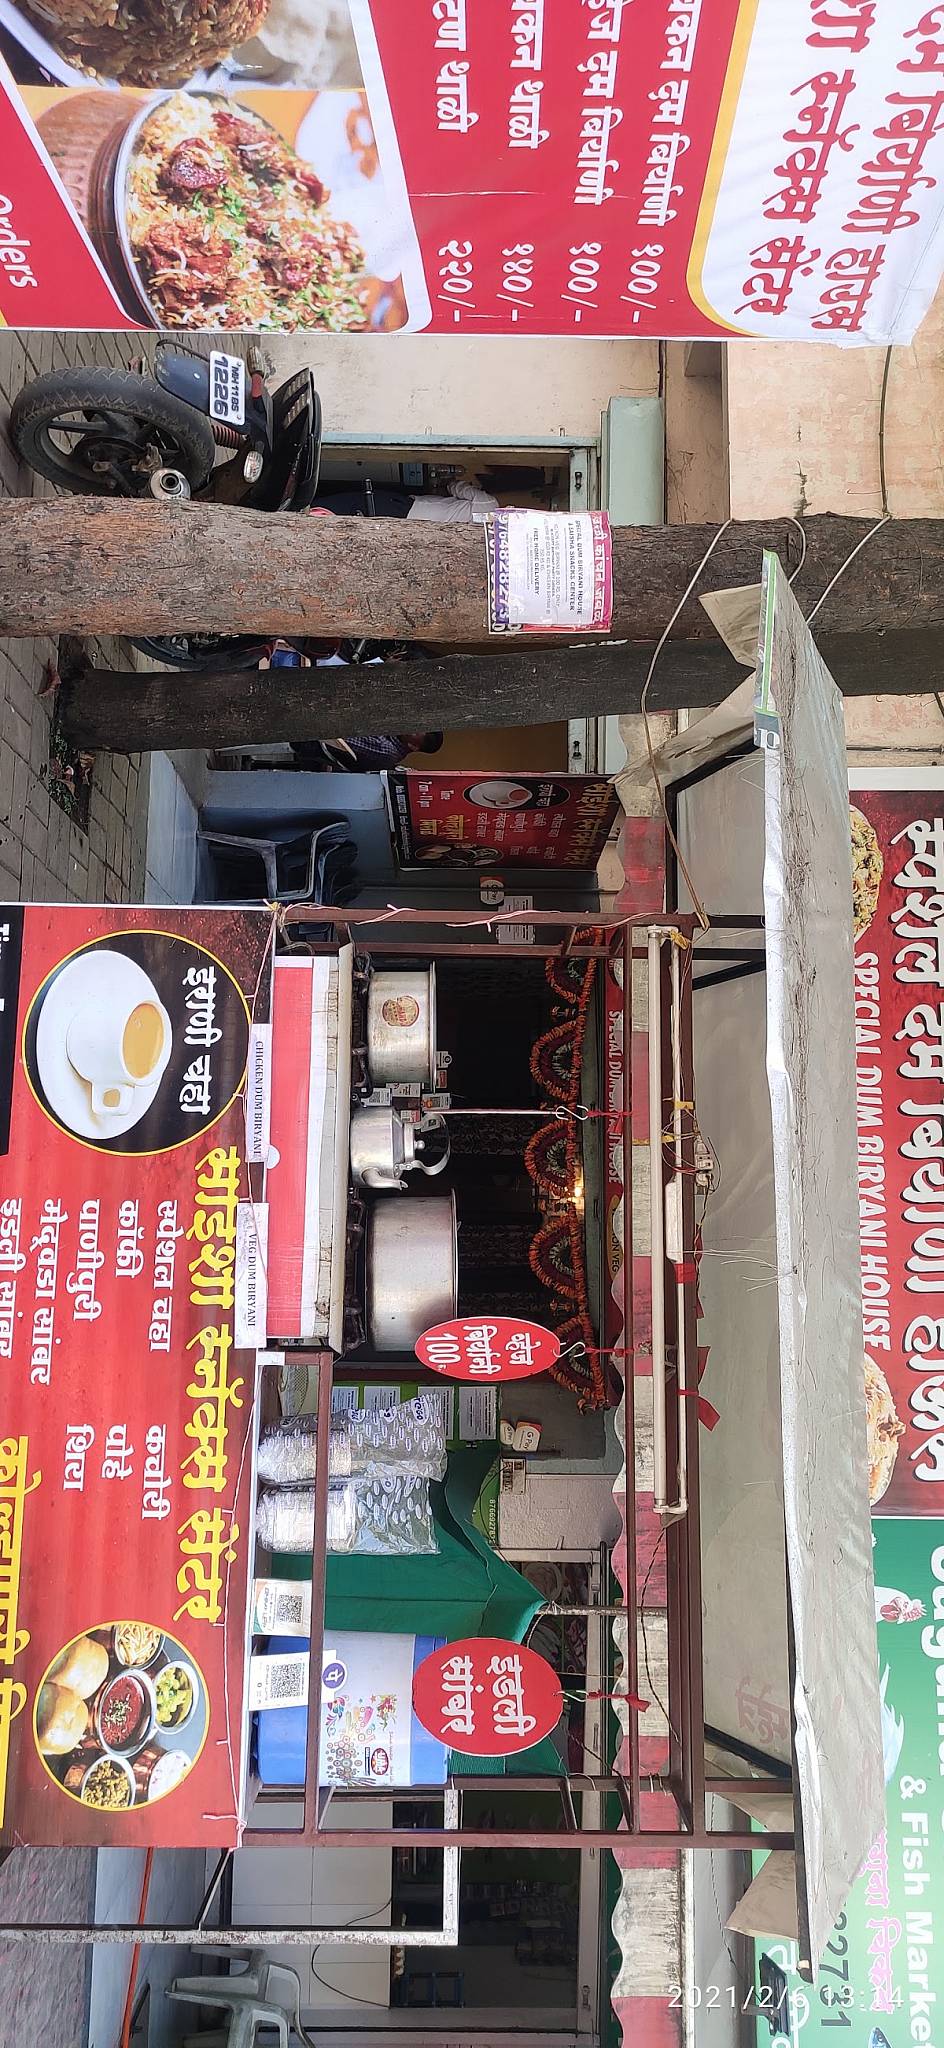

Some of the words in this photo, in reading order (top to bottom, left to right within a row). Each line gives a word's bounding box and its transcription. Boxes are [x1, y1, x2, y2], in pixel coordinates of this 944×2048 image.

[577, 51, 618, 98] दम
[896, 4, 944, 73] दम
[436, 61, 479, 133] थाळी
[508, 80, 549, 149] थाळी
[647, 80, 688, 125] दम
[573, 106, 624, 206] बिर्याणी
[637, 133, 691, 227] बिर्याणी
[762, 69, 861, 224] स्नॅक्स
[841, 91, 944, 234] बिर्याणी
[436, 240, 475, 322] २२०/-
[496, 243, 535, 322] १४०/-
[560, 242, 602, 322] १००/-
[619, 243, 665, 323] १००/-
[734, 235, 821, 316] सेंटर
[810, 244, 886, 332] हाउस
[214, 356, 228, 416] 1226
[576, 590, 584, 615] HOUSE
[182, 966, 223, 1048] इराणी
[854, 952, 882, 1055] SPECIAL
[254, 1041, 264, 1084] CHICKEN
[894, 1004, 944, 1083] दम
[179, 1054, 212, 1115] चहा
[254, 1087, 263, 1110] DUM
[855, 1066, 883, 1128] DUM
[254, 1112, 262, 1155] BIRYANI
[186, 1146, 241, 1309] साइशा
[857, 1134, 888, 1248] BIRYANI
[0, 1198, 27, 1273] इडली
[30, 1198, 68, 1300] मेदूवडा
[66, 1198, 106, 1322] पाणीपुरी
[114, 1200, 145, 1278] कॉफी
[152, 1200, 184, 1290] स्पेशल
[248, 1234, 257, 1254] VEG
[248, 1256, 256, 1280] DUM
[612, 1254, 620, 1272] VEG
[0, 1280, 24, 1359] सांबर
[148, 1296, 172, 1352] चहा
[247, 1283, 256, 1326] BIRYANI
[861, 1254, 892, 1350] HOUSE
[30, 1306, 62, 1386] सांबर
[424, 1333, 462, 1364] 100
[462, 1325, 502, 1374] बिर्यानी
[506, 1332, 542, 1366] व्हेज
[184, 1324, 244, 1493] स्नॅक्स
[524, 1438, 533, 1450] Pay
[63, 1424, 96, 1491] शिरा
[100, 1424, 134, 1480] पोहे
[140, 1424, 172, 1520] कचोरी
[172, 1507, 240, 1624] सेंटर
[440, 1655, 484, 1736] सांबर
[486, 1654, 536, 1737] इडली
[900, 1775, 927, 1800] &
[855, 1828, 889, 1908] गुना
[901, 1811, 930, 1896] Fish
[866, 1918, 902, 2014] चिकन
